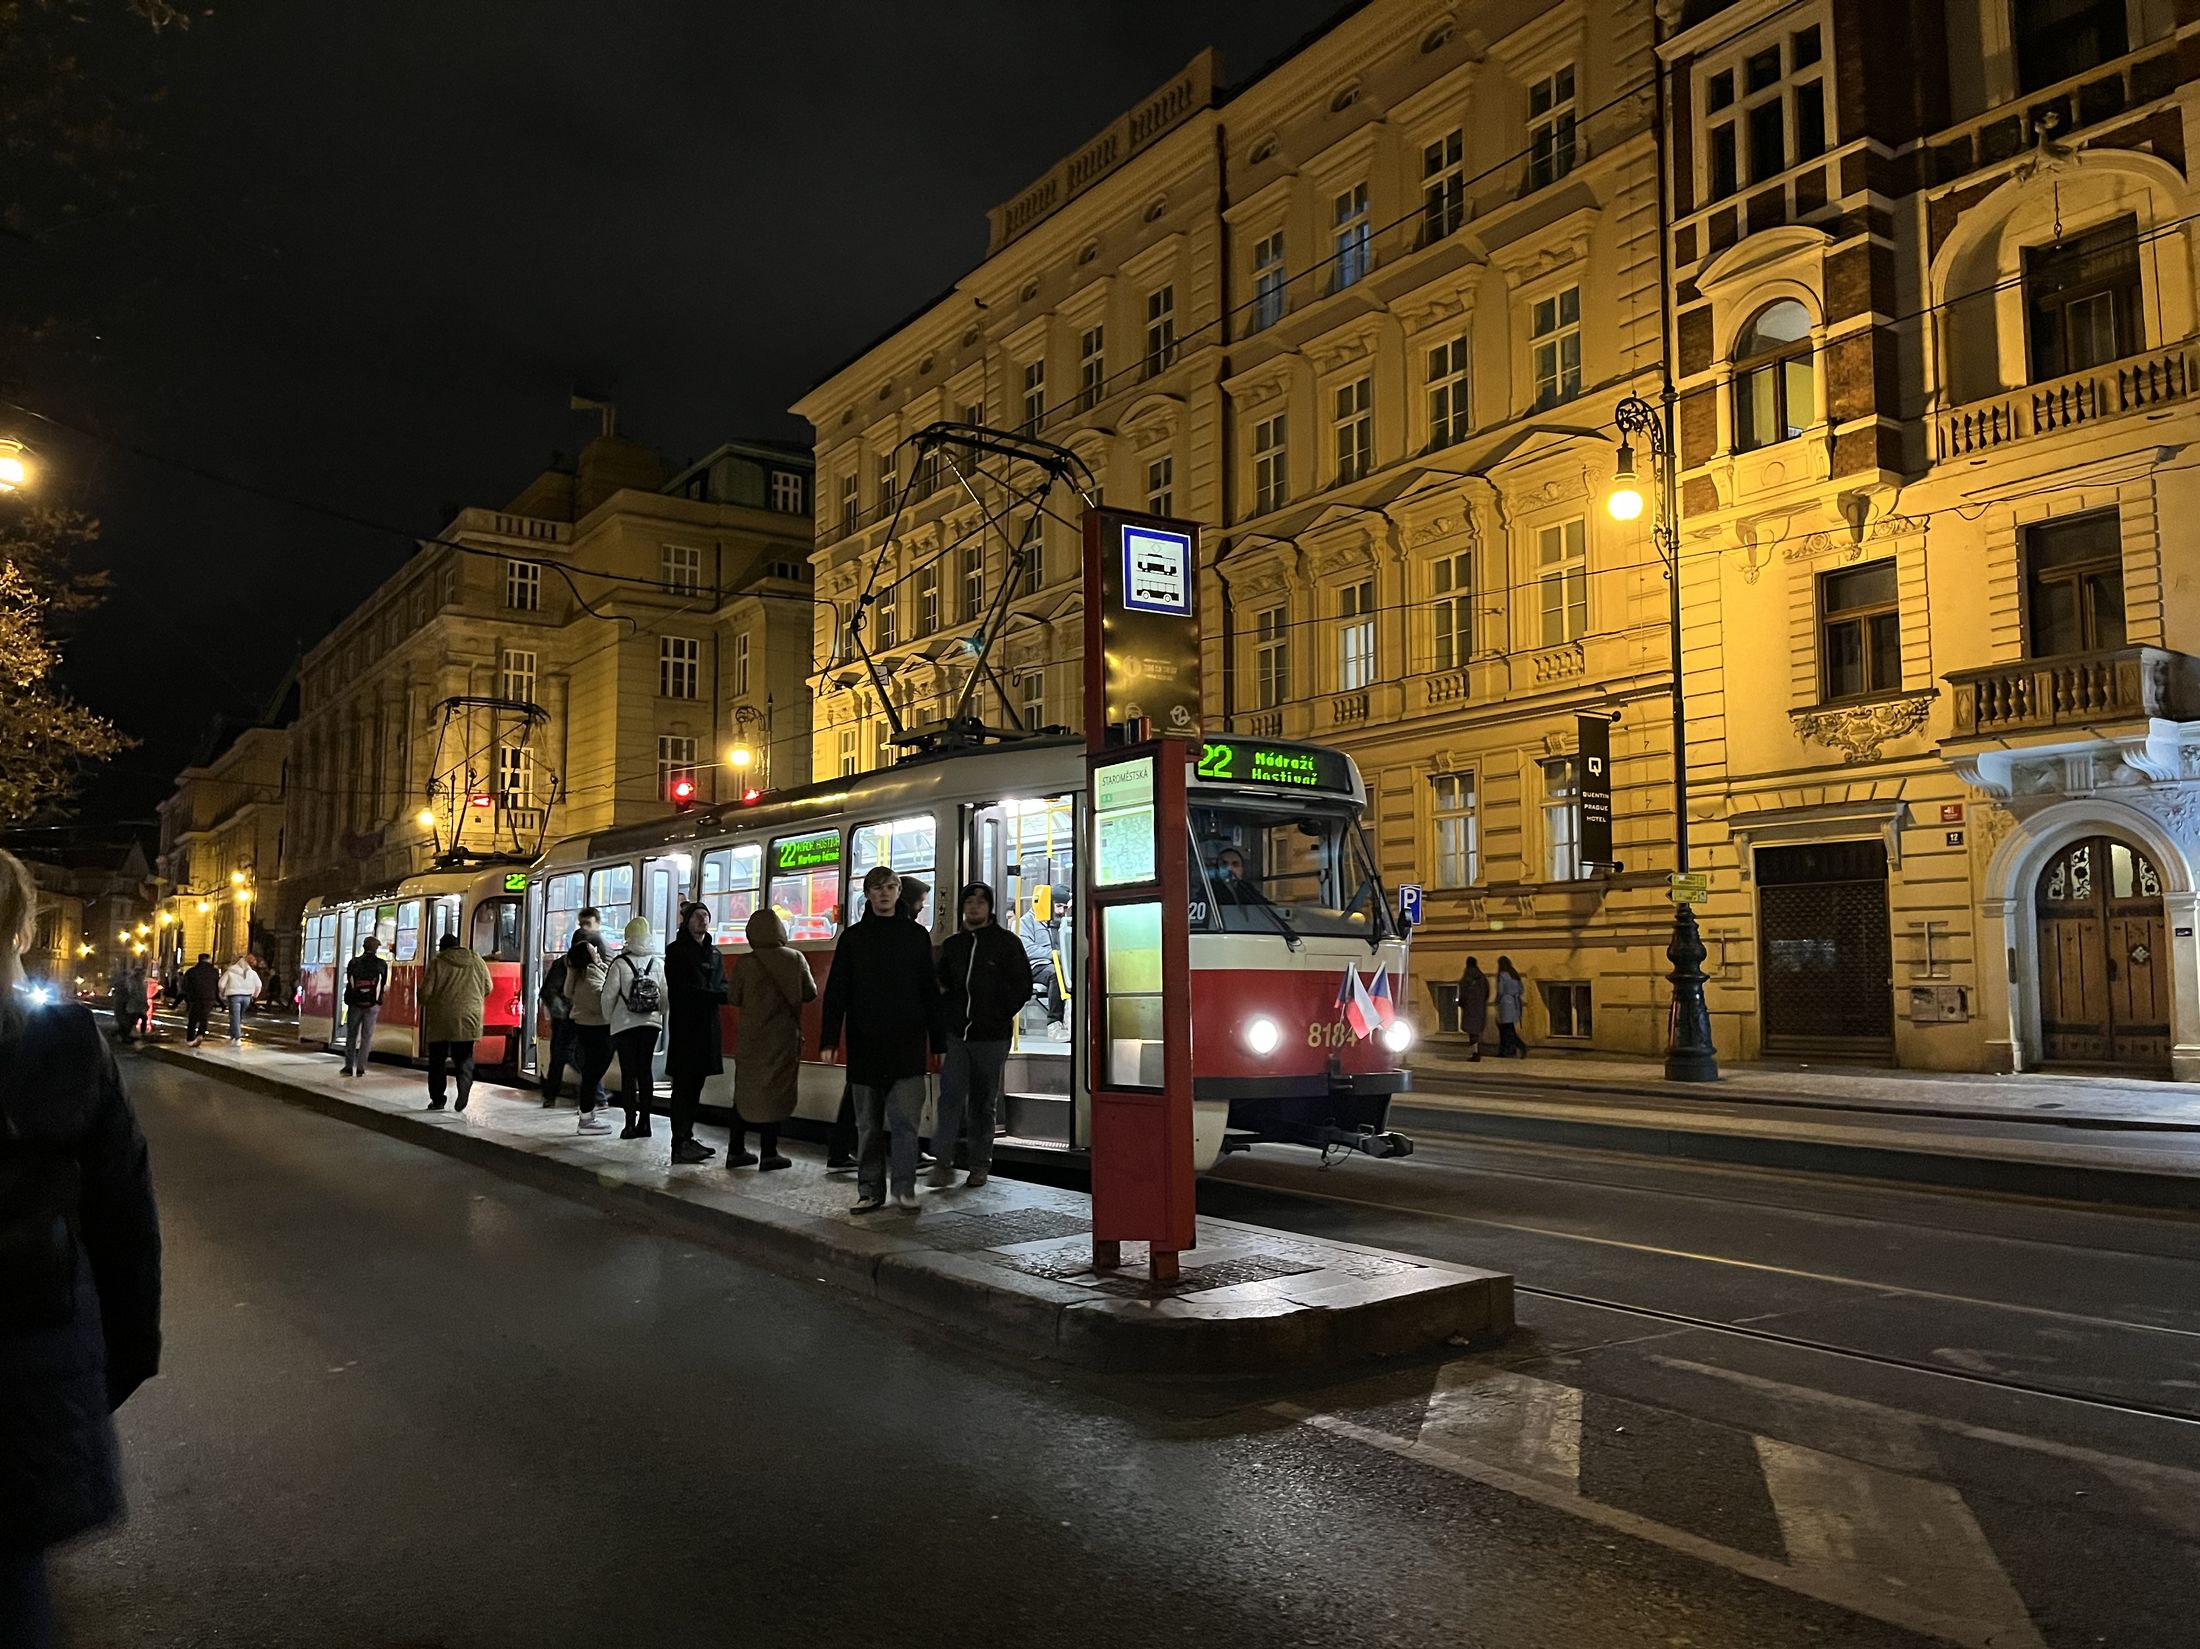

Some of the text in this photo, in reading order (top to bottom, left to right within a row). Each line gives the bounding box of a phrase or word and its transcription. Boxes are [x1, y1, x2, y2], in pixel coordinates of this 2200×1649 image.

[1198, 744, 1232, 778] 22
[1255, 752, 1315, 770] Nádraží
[1589, 757, 1601, 777] Q
[1252, 768, 1317, 785] Hostivař
[1582, 791, 1609, 800] QUENTIN
[1584, 803, 1608, 812] PRAGUE
[1586, 815, 1606, 823] HOTEL
[780, 843, 796, 867] 22
[1404, 890, 1417, 908] P
[1188, 902, 1206, 920] 20
[1308, 1022, 1357, 1048] 8184
